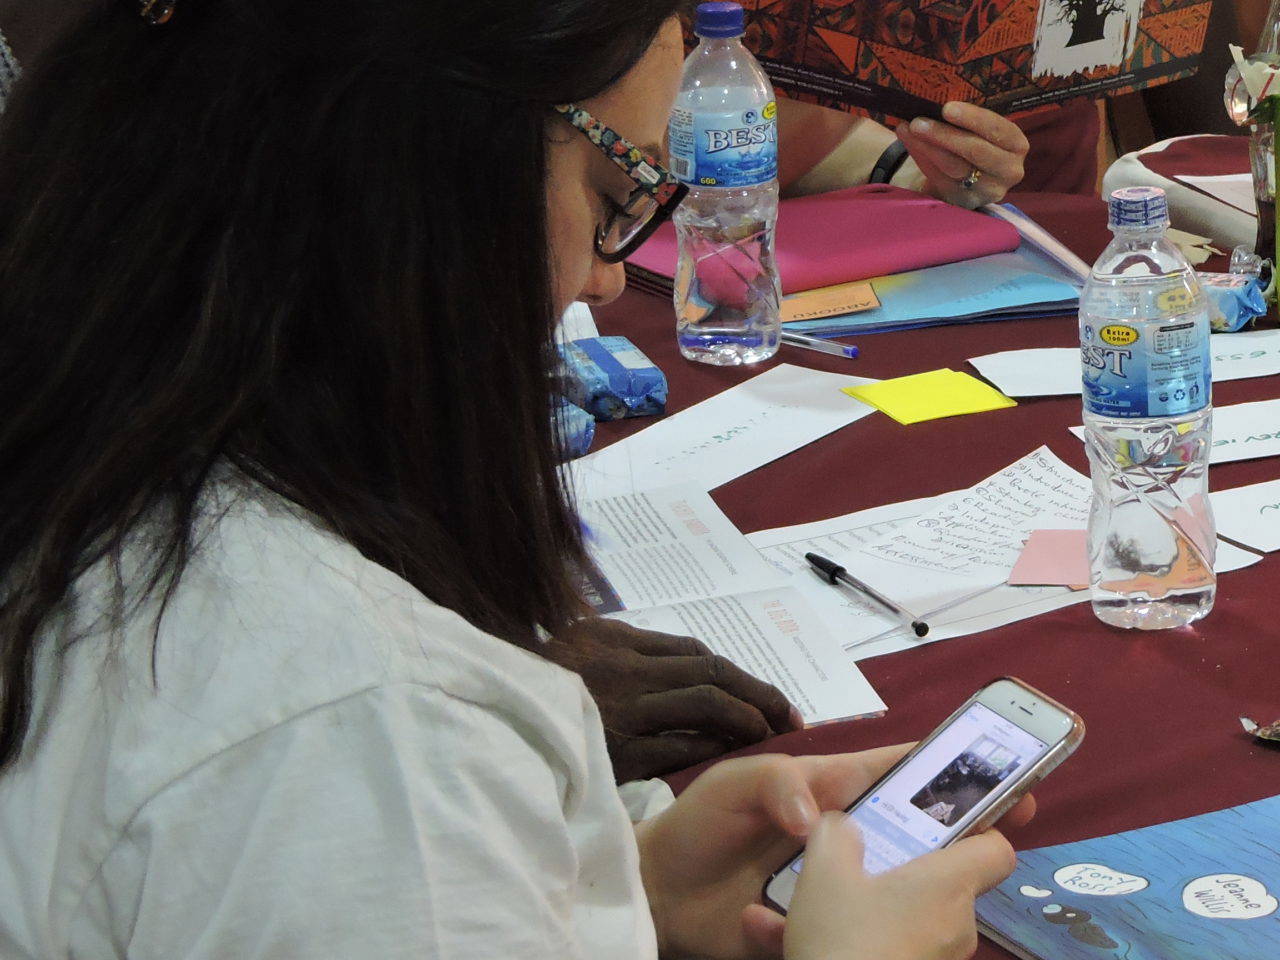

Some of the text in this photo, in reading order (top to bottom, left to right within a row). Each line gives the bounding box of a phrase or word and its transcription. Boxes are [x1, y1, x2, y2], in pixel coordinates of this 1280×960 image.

[1106, 329, 1131, 337] Extra
[1076, 866, 1138, 886] Tony
[1193, 888, 1232, 914] Willis
[1216, 877, 1262, 910] Jeanne
